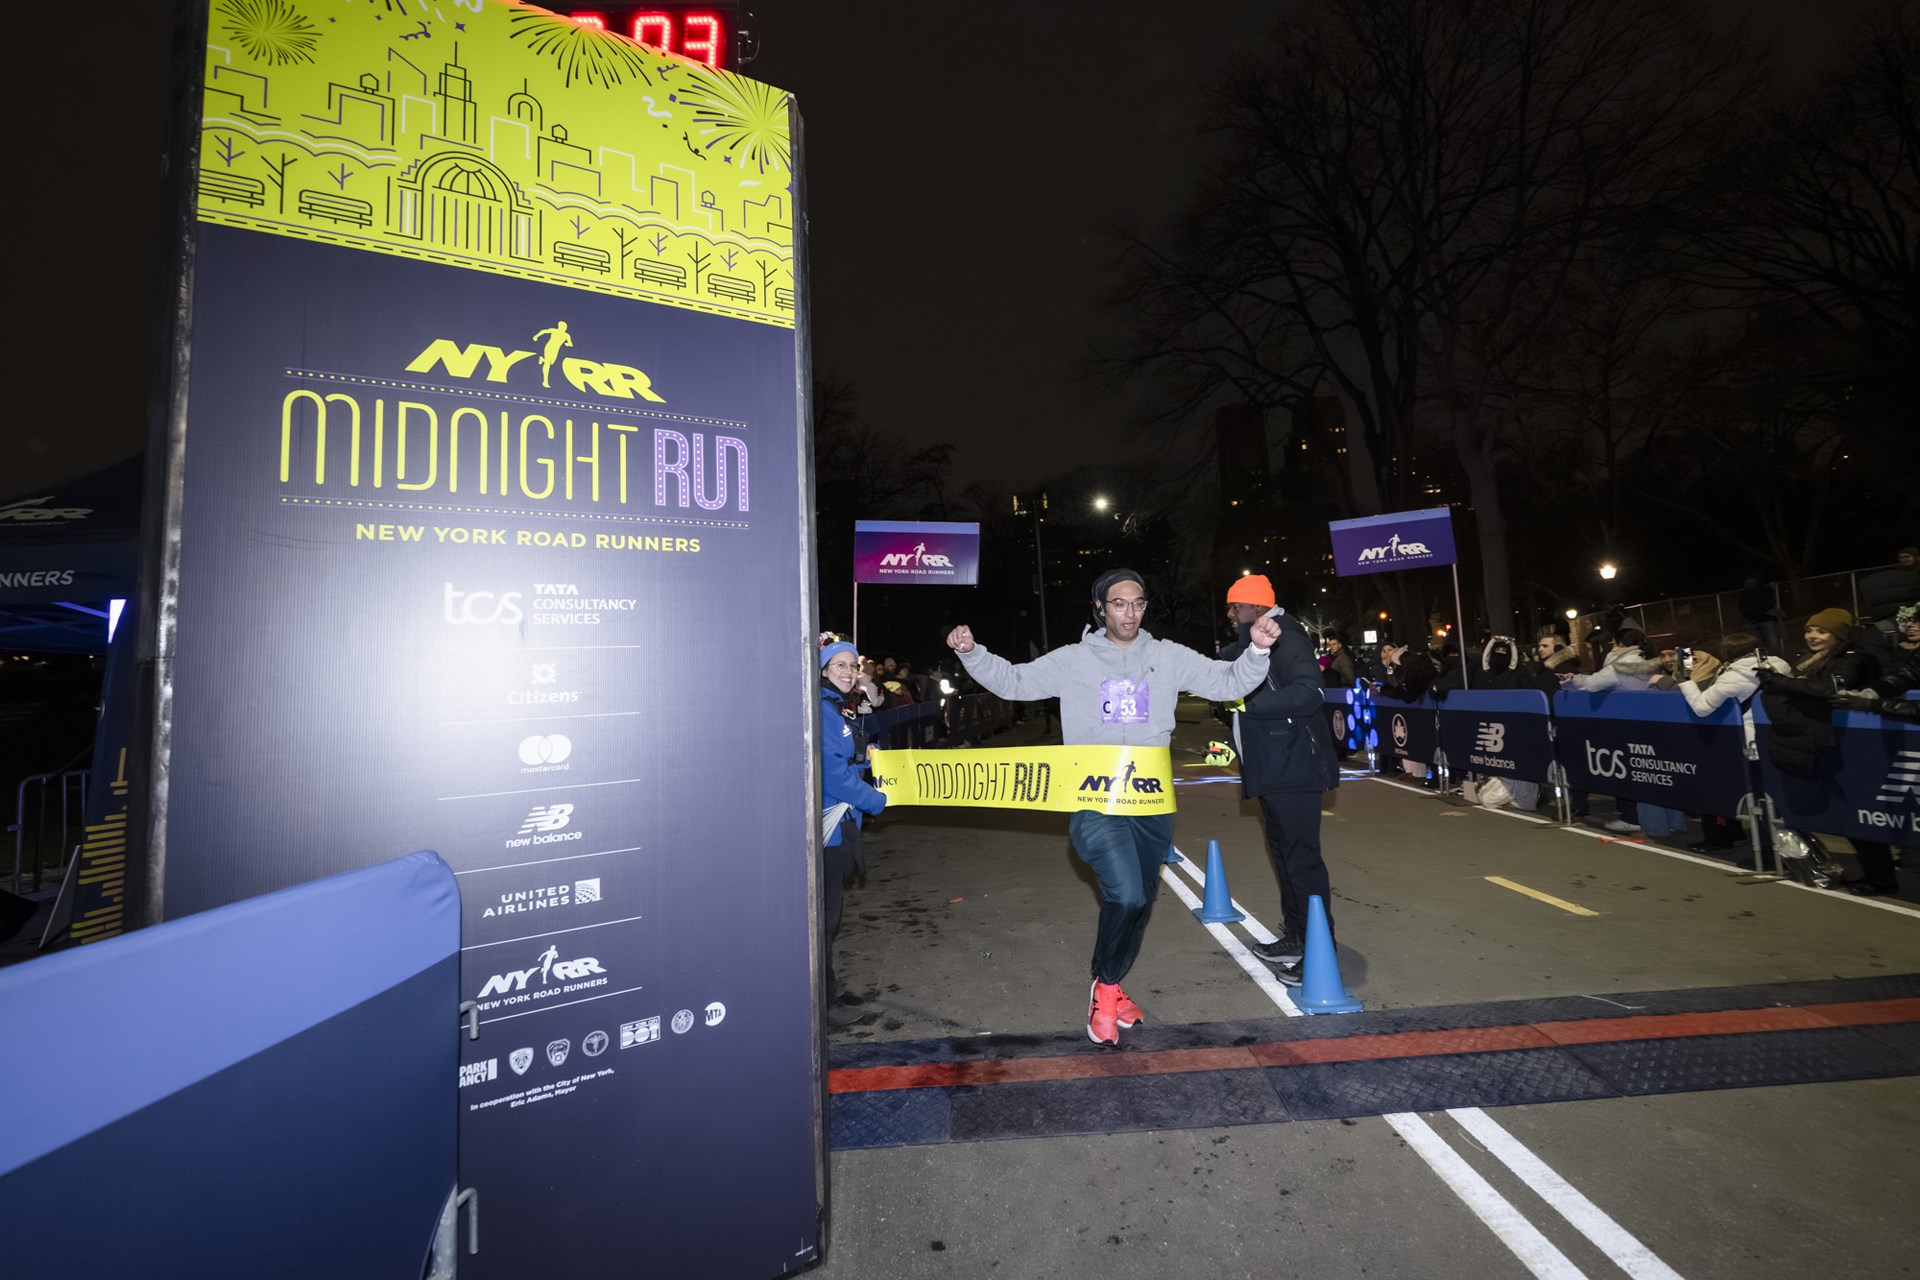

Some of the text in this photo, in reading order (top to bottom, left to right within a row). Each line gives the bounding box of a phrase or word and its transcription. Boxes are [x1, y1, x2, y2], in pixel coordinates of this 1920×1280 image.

[404, 338, 667, 403] NYRR
[280, 389, 750, 512] MIDNIGHT RUN
[355, 523, 701, 553] NEW YORK ROAD RUNNERS
[880, 553, 954, 567] NYRR
[1358, 542, 1431, 561] NYRR
[533, 583, 579, 595] TATA
[444, 582, 524, 625] tcs
[533, 598, 637, 611] CONSULTANCY
[533, 612, 601, 625] SERVICES
[507, 691, 580, 704] Citizens
[1103, 699, 1137, 716] C 53
[1627, 743, 1656, 756] TATA
[1470, 754, 1515, 770] new balance
[1585, 739, 1627, 779] tcs
[1629, 757, 1697, 775] CONSULTANCY
[520, 764, 570, 774] mastercard
[1631, 770, 1674, 786] SERVICES
[916, 762, 1051, 802] MIDNIGHT RUN
[1079, 775, 1164, 793] NYRR
[1858, 809, 1905, 829] new
[505, 831, 582, 849] new balance
[501, 885, 570, 904] UNITED
[482, 895, 571, 918] AIRLINES
[477, 957, 607, 998] NYRR
[477, 977, 609, 1011] NEW YORK ROAD RUNNERS
[705, 1009, 722, 1021] MTA
[622, 1023, 660, 1046] DOT
[459, 1059, 488, 1077] PARK
[480, 1092, 525, 1109] cooperation
[526, 1086, 542, 1095] with
[543, 1083, 555, 1092] the
[556, 1079, 571, 1089] City
[581, 1073, 596, 1082] New
[597, 1068, 615, 1077] York,
[510, 1085, 577, 1108] Eric Adams, Mayor
